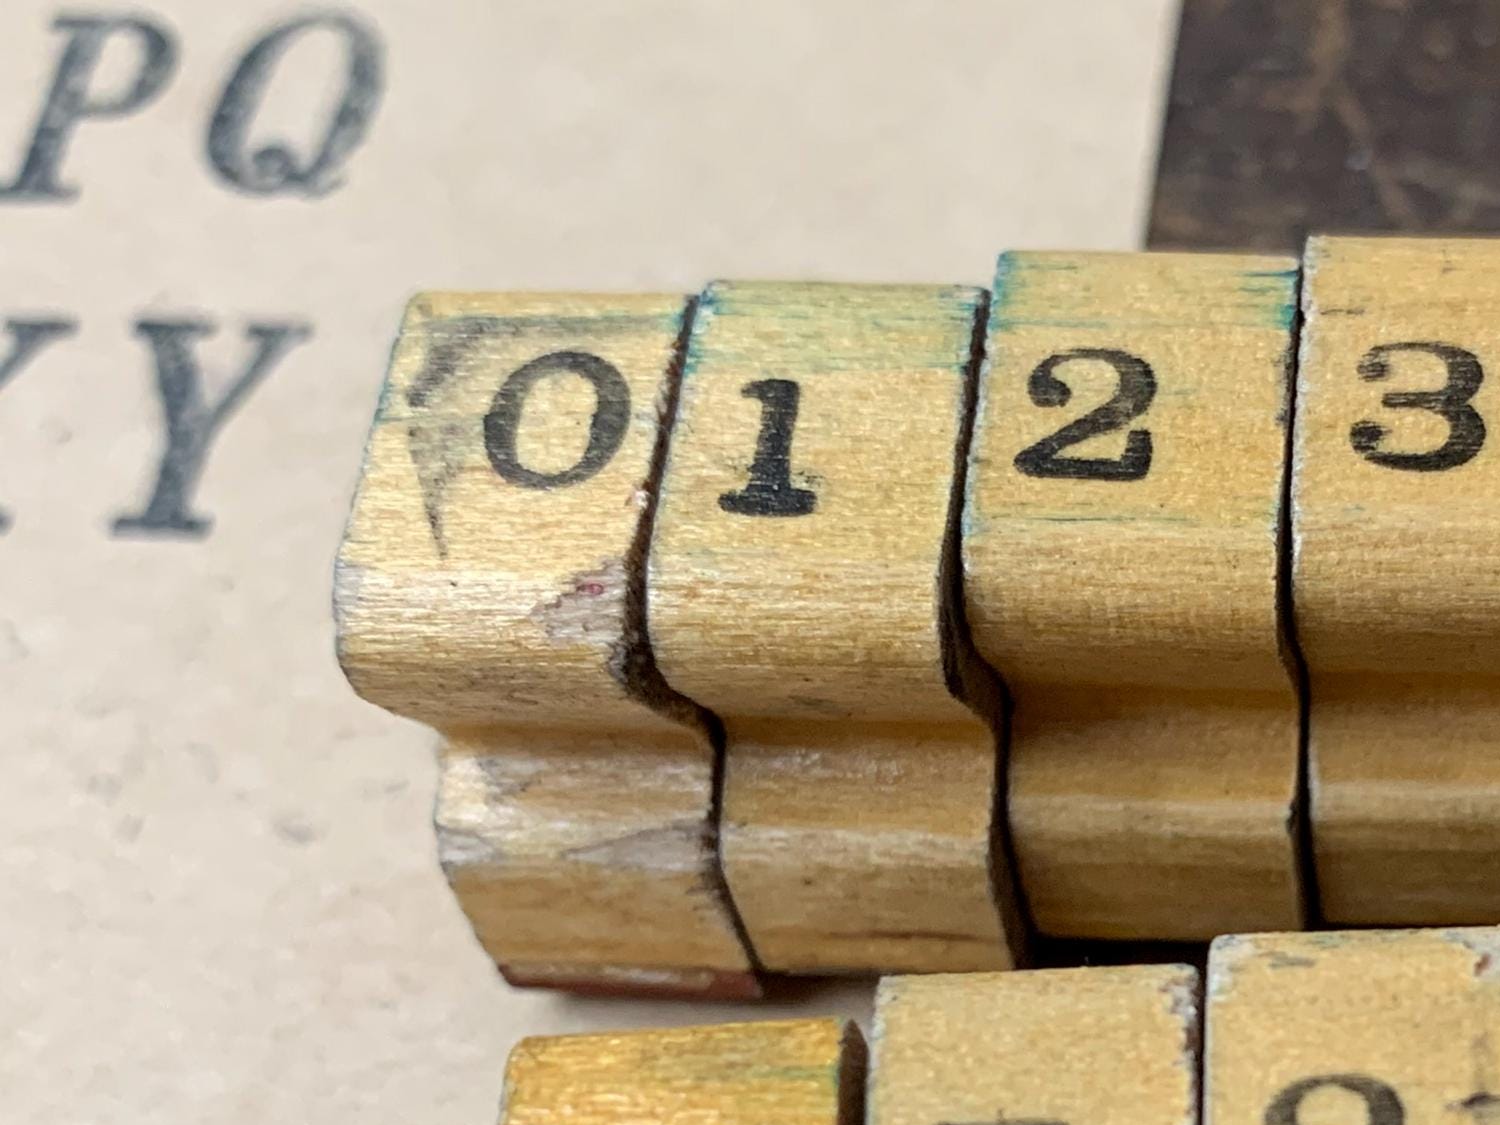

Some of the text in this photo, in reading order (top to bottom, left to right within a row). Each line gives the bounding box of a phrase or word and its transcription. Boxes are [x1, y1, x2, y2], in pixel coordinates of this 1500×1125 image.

[481, 348, 632, 492] 0
[717, 378, 819, 518] 1
[1012, 347, 1160, 483] 2
[1349, 340, 1488, 473] 3
